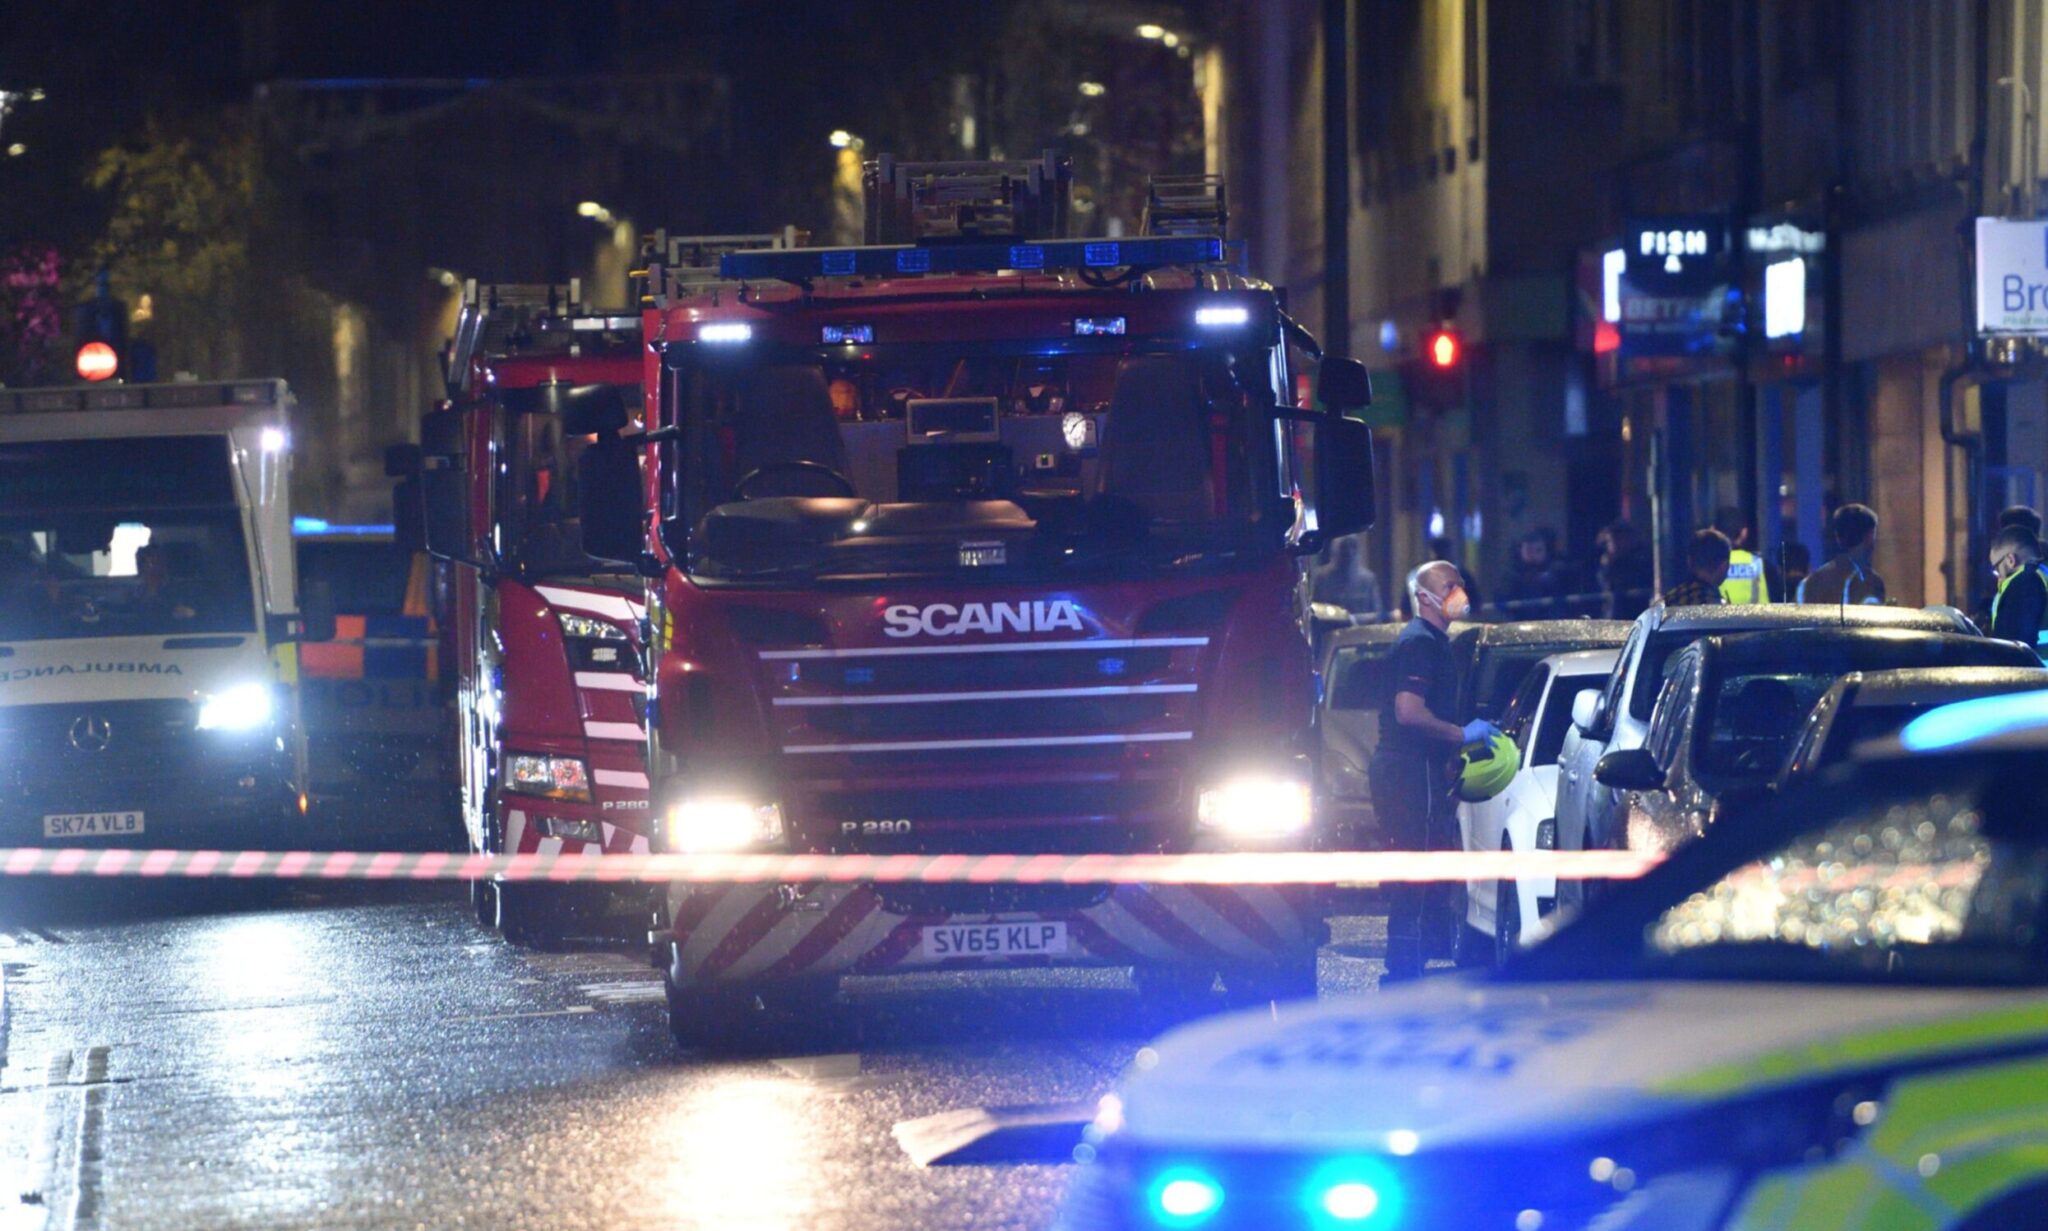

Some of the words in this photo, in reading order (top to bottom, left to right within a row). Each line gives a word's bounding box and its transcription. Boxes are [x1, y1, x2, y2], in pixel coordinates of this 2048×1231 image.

[1640, 230, 1708, 256] FISH
[2002, 273, 2048, 313] Br
[882, 599, 1085, 638] SCANIA
[602, 801, 615, 811] P
[616, 800, 649, 811] 280
[50, 815, 97, 835] SK74
[101, 813, 136, 832] VLB
[841, 821, 858, 836] P
[862, 819, 912, 835] 280
[933, 927, 1000, 954] SV65
[1007, 926, 1057, 951] KLP
